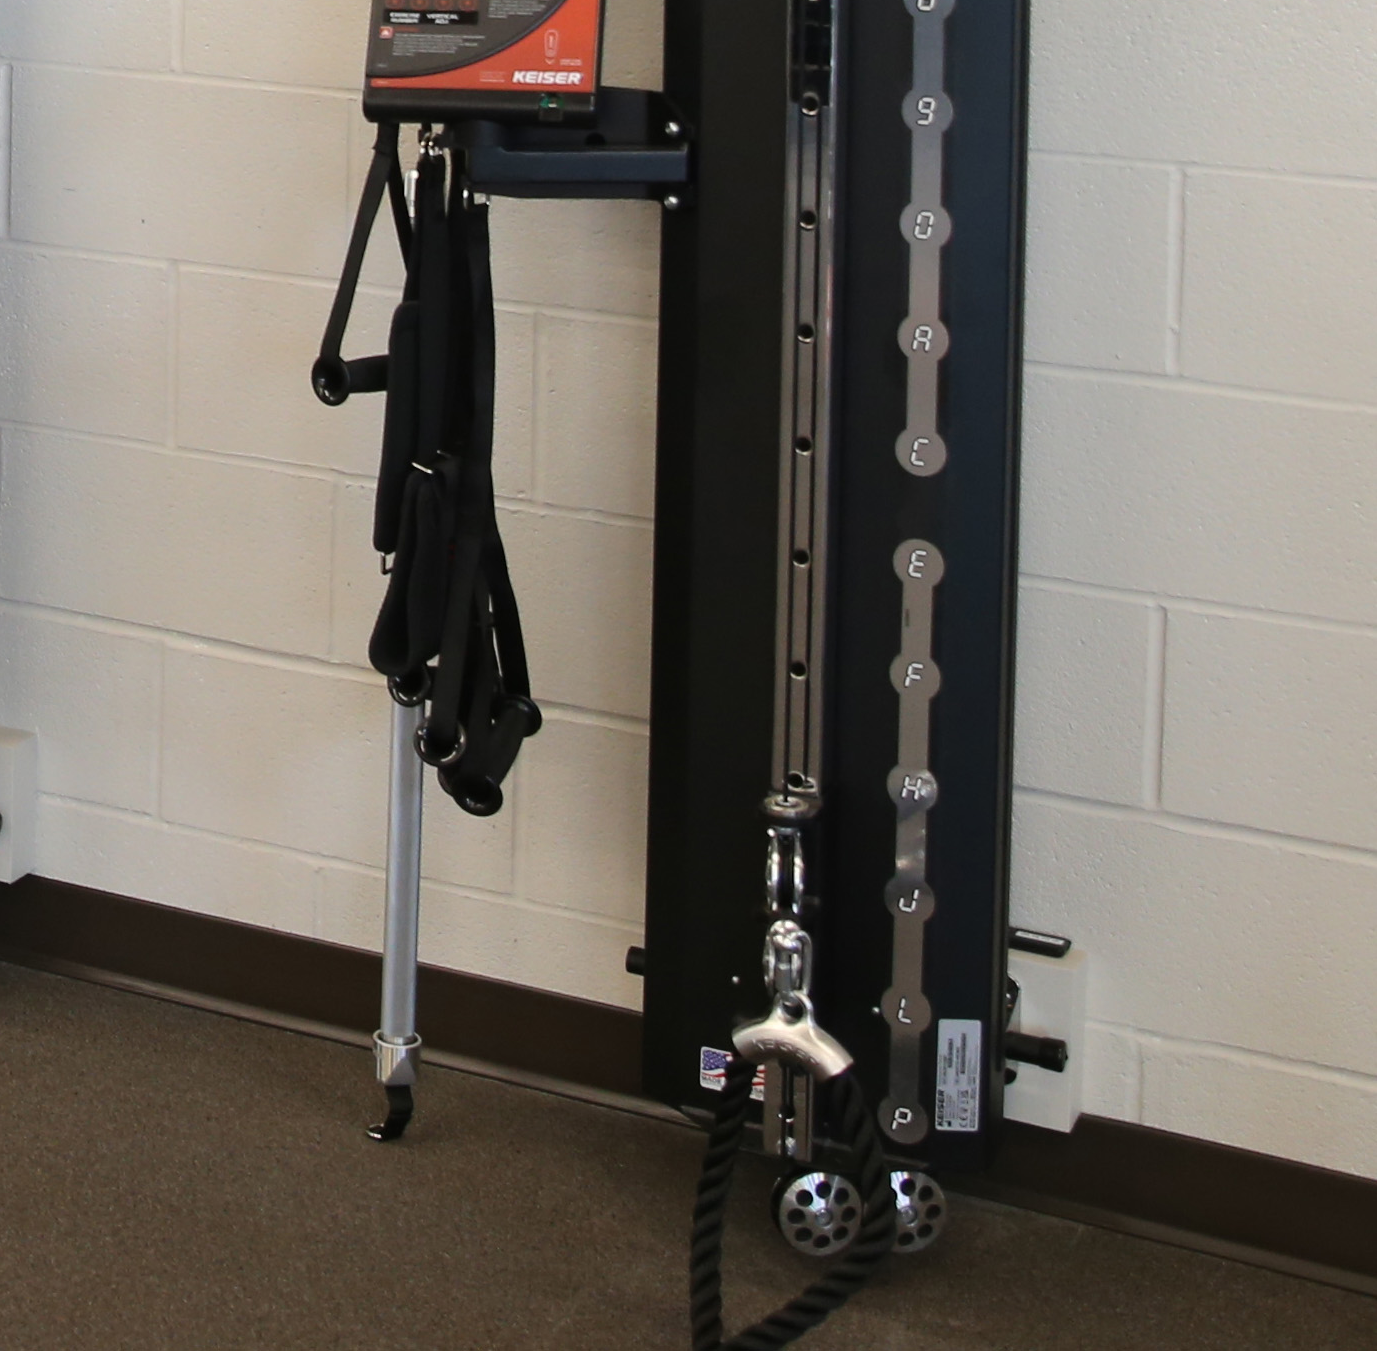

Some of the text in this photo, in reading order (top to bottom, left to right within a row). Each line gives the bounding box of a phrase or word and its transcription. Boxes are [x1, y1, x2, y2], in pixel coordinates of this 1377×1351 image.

[512, 70, 583, 85] KEISER
[916, 96, 935, 126] 9
[910, 437, 930, 466] C
[907, 549, 928, 578] E
[936, 1089, 946, 1127] KEISER
